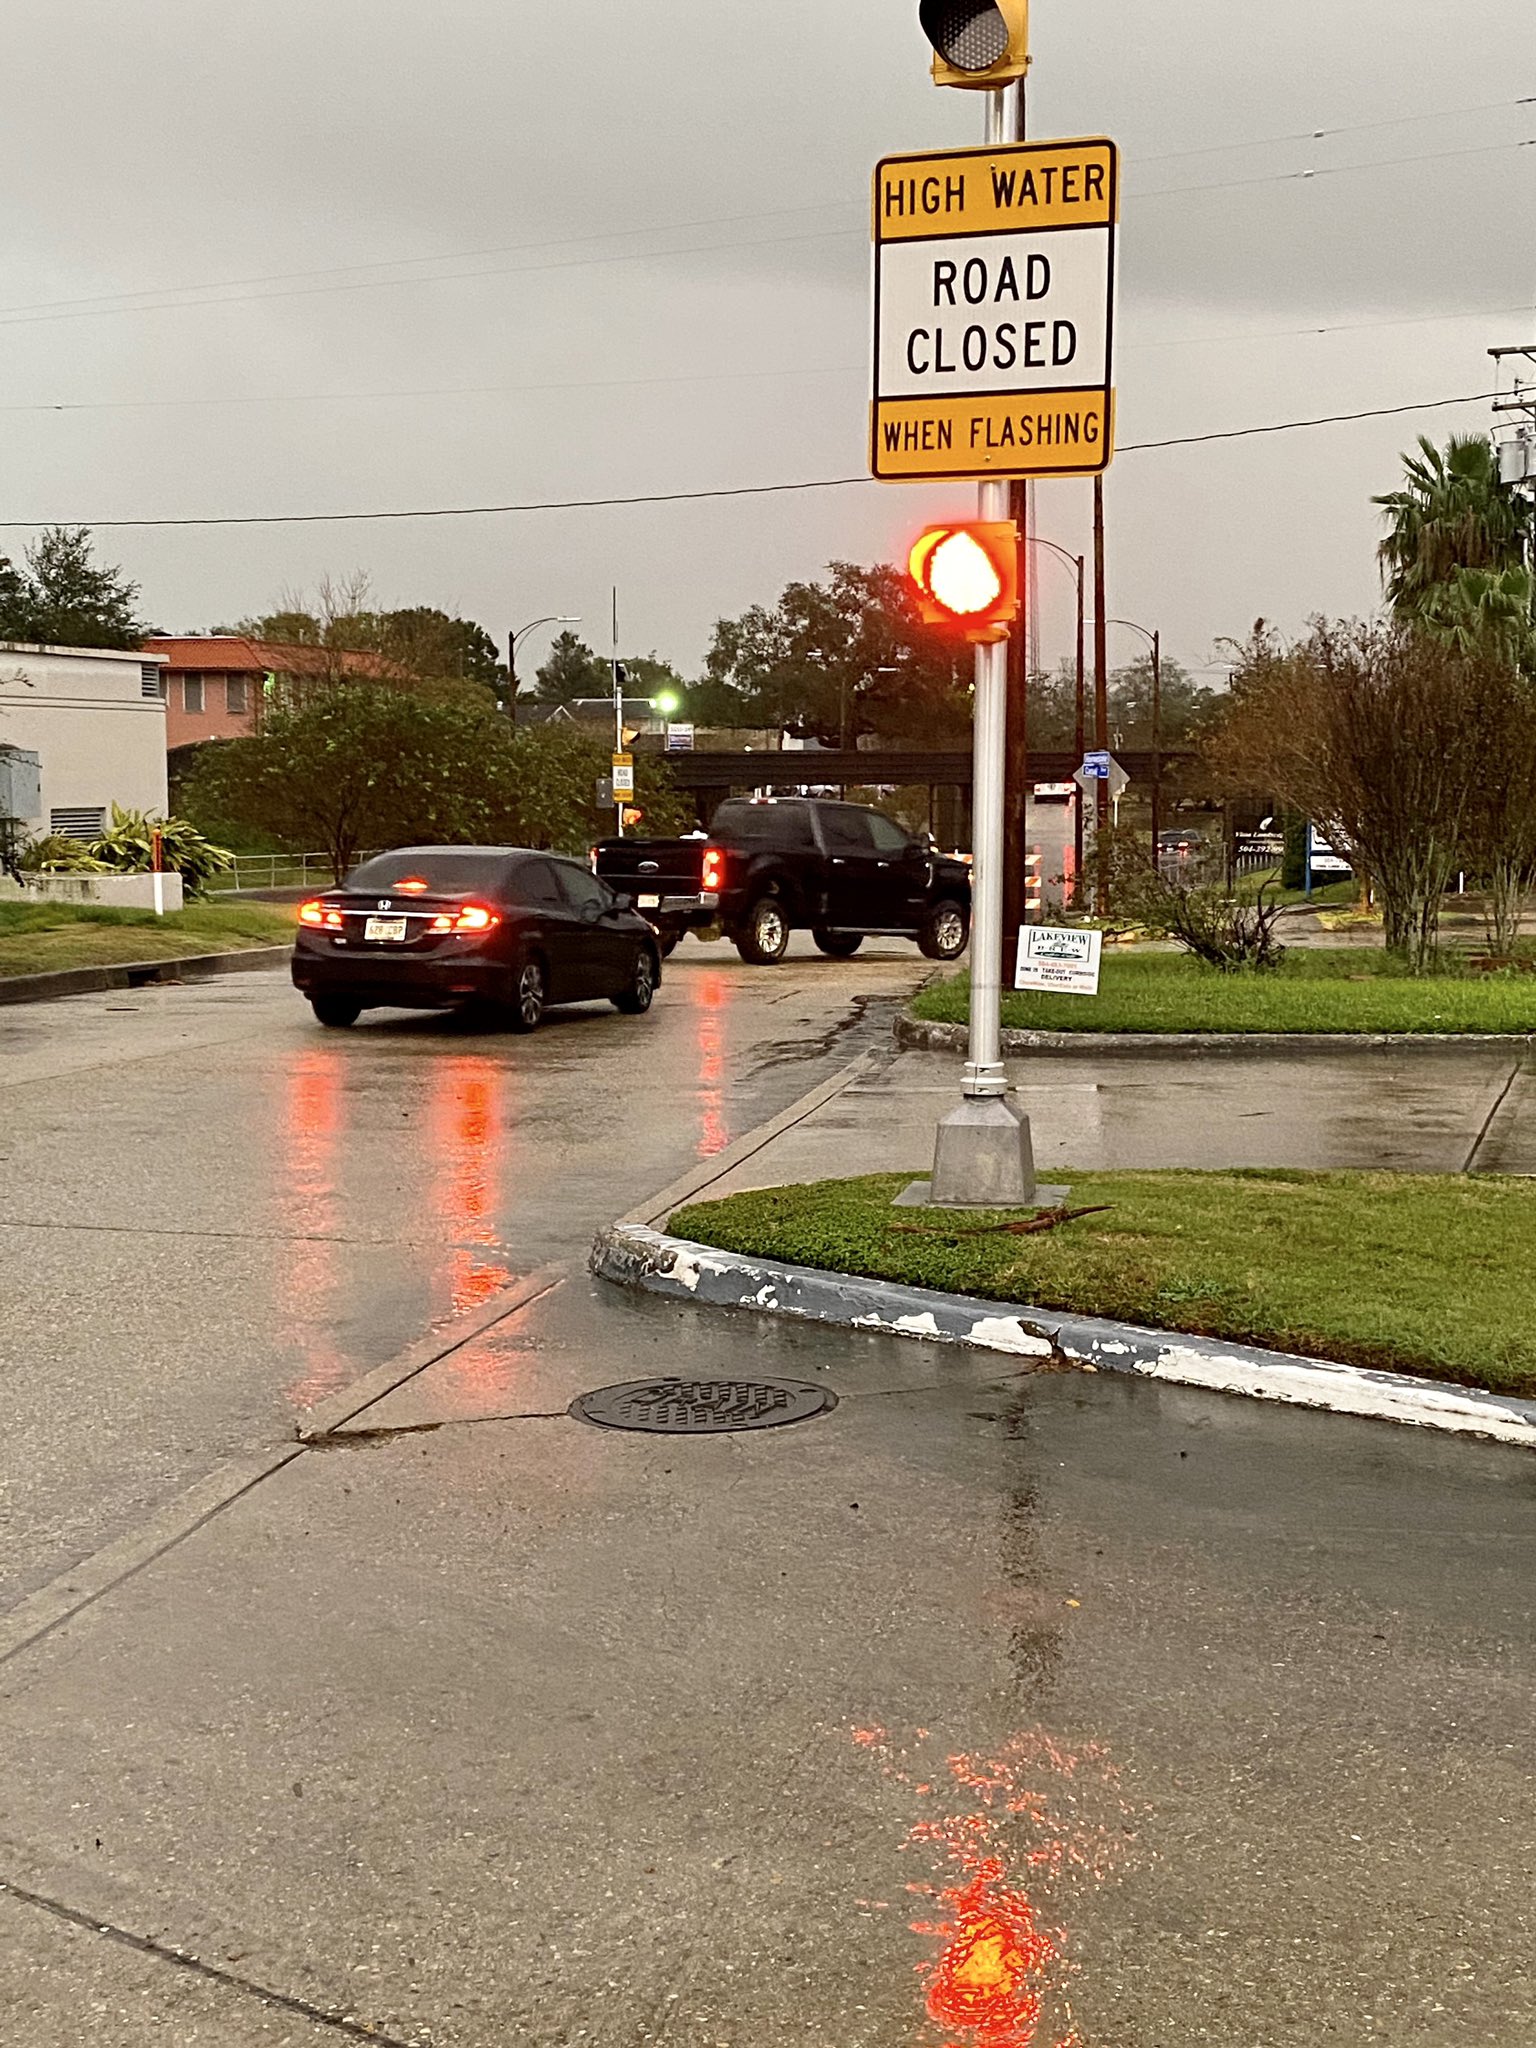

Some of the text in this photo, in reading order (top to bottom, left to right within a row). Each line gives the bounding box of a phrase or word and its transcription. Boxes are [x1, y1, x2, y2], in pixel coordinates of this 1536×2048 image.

[885, 163, 1105, 217] HIGH WATER
[934, 253, 1051, 307] ROAD
[907, 319, 1077, 375] CLOSED
[884, 411, 1099, 452] WHEN FLASHING
[1032, 931, 1088, 945] LAKEVIEW
[1041, 974, 1073, 982] DELIVERY
